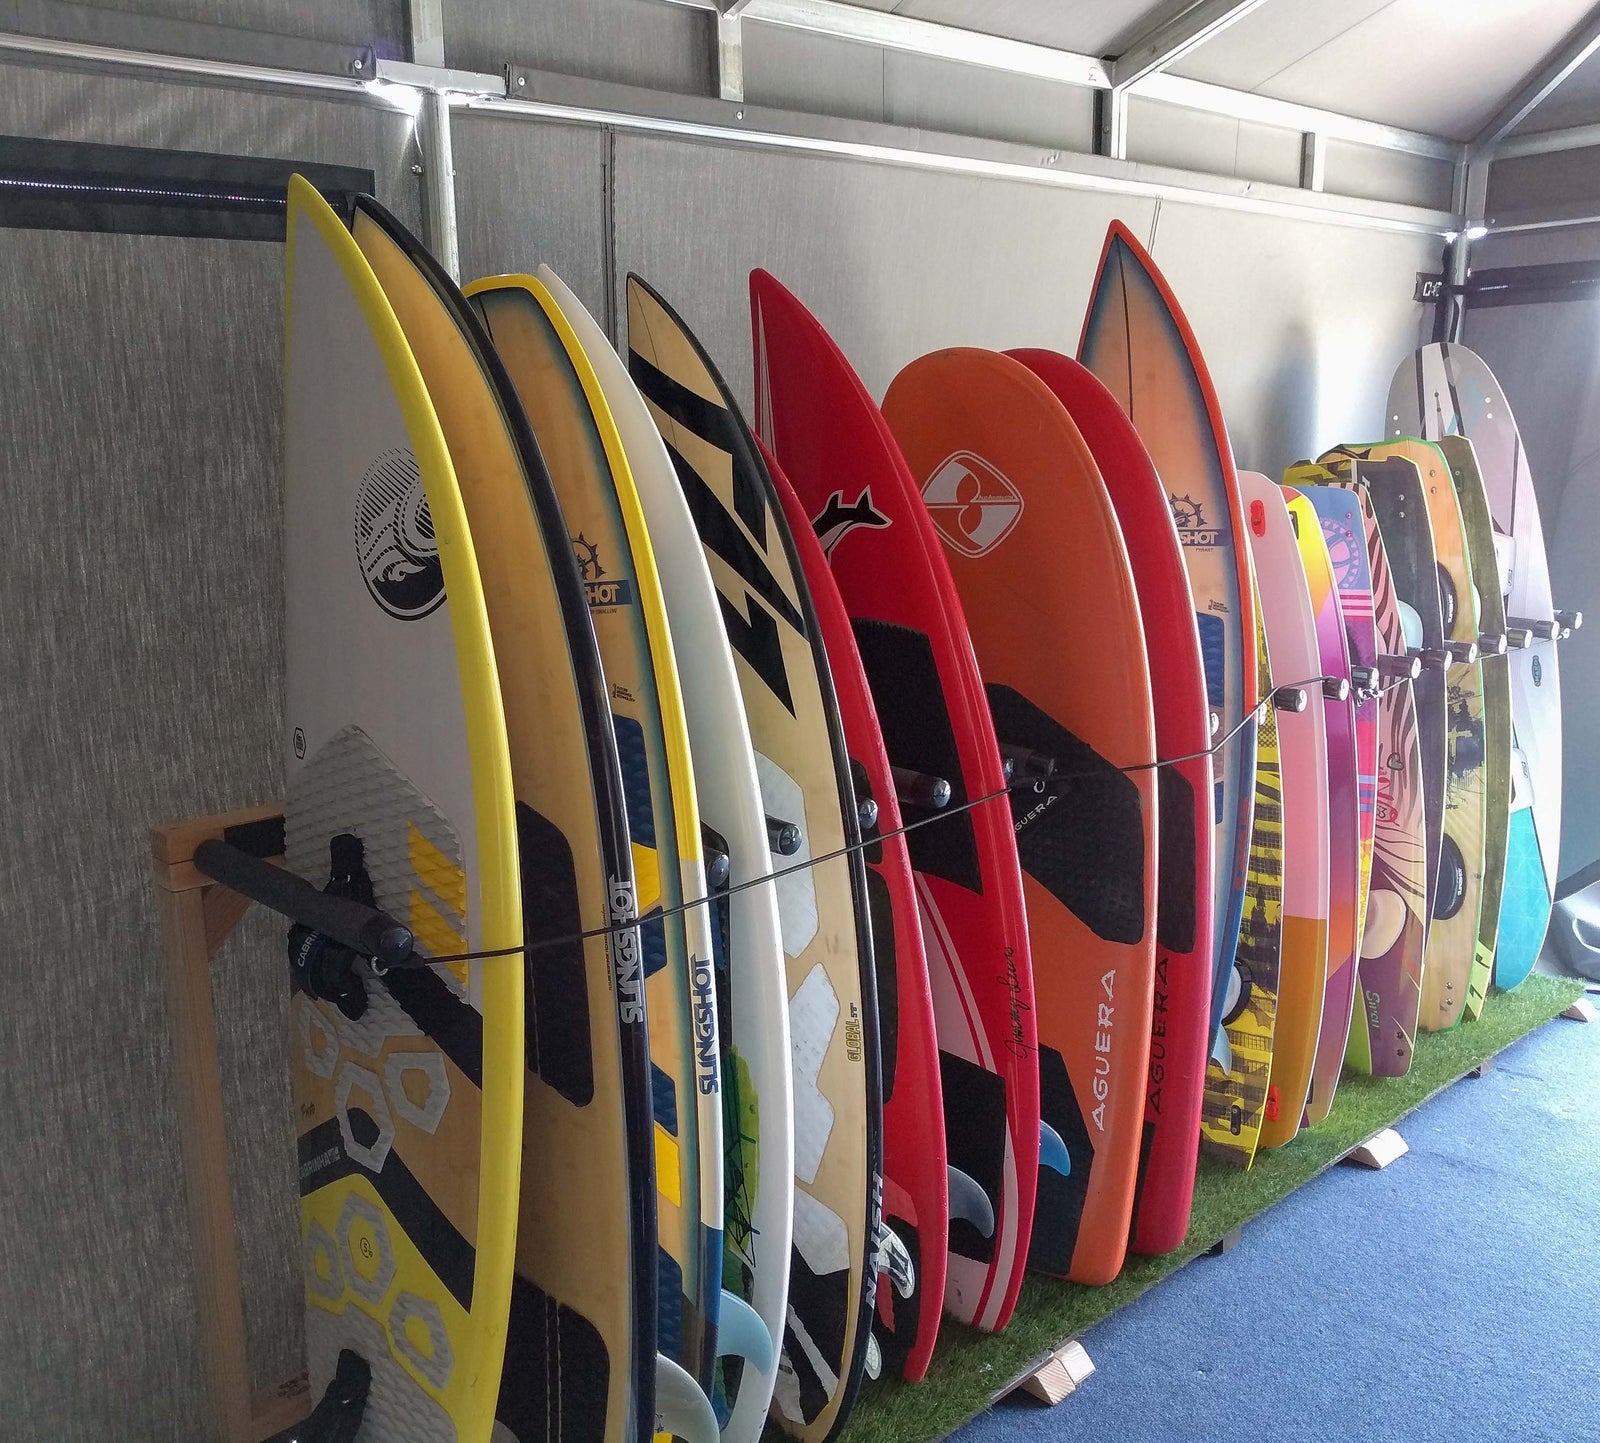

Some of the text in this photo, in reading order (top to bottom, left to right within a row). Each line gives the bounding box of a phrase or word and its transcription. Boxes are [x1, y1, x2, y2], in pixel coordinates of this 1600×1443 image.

[1014, 796, 1058, 832] GUERA
[608, 873, 644, 1024] SLINGSHOT
[690, 953, 719, 1095] SLINGSHOT
[845, 1019, 861, 1062] GLOBAL
[1091, 968, 1116, 1132] AGUERA
[1150, 957, 1169, 1114] AGUERA
[865, 1171, 883, 1310] NAISH
